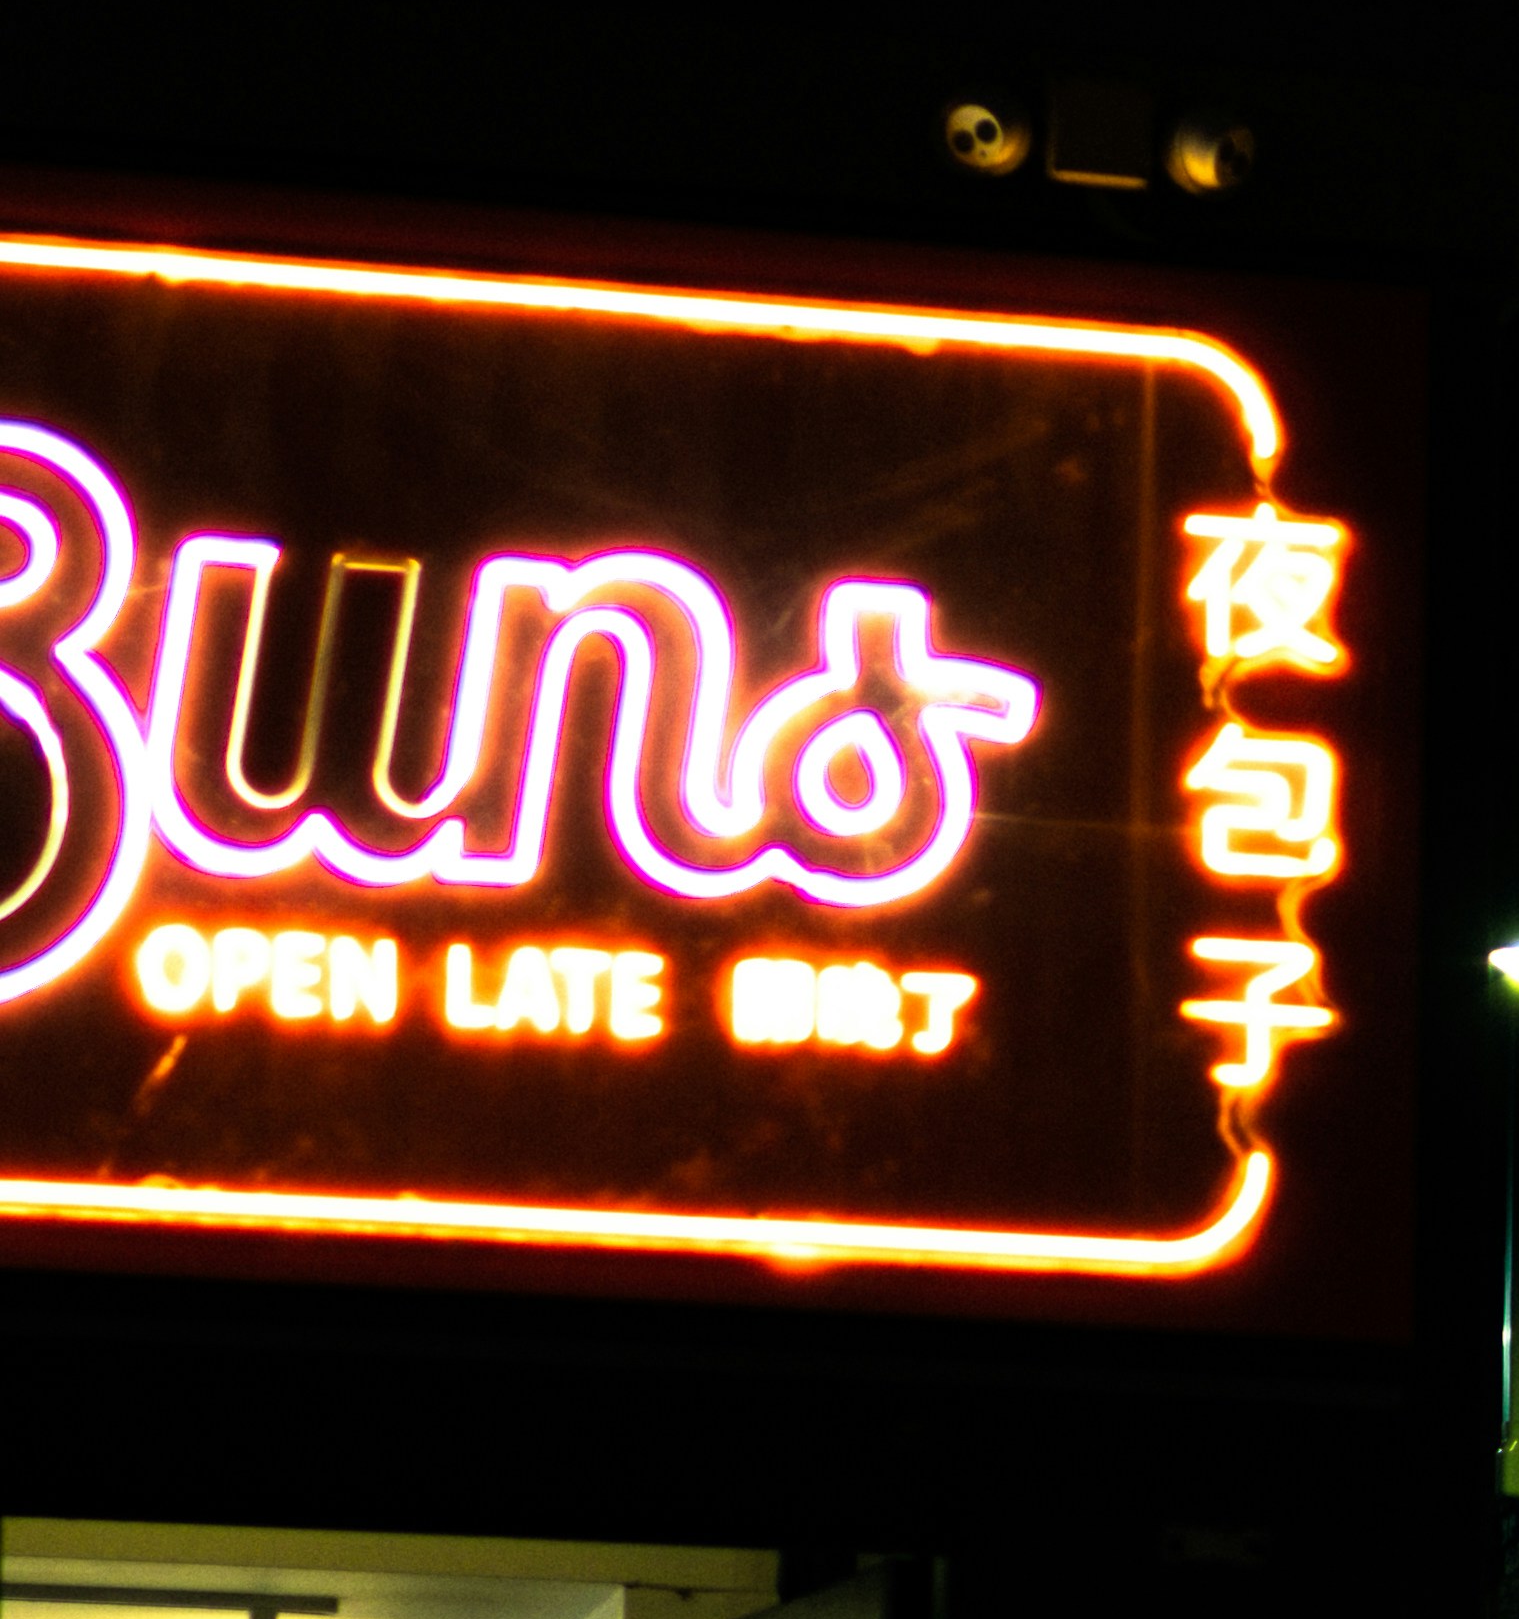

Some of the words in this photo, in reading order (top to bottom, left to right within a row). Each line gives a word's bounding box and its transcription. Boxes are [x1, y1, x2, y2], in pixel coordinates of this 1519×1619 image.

[1184, 503, 1350, 1087] 夜包子
[137, 925, 398, 1027] OPEN
[444, 942, 664, 1041] LATE
